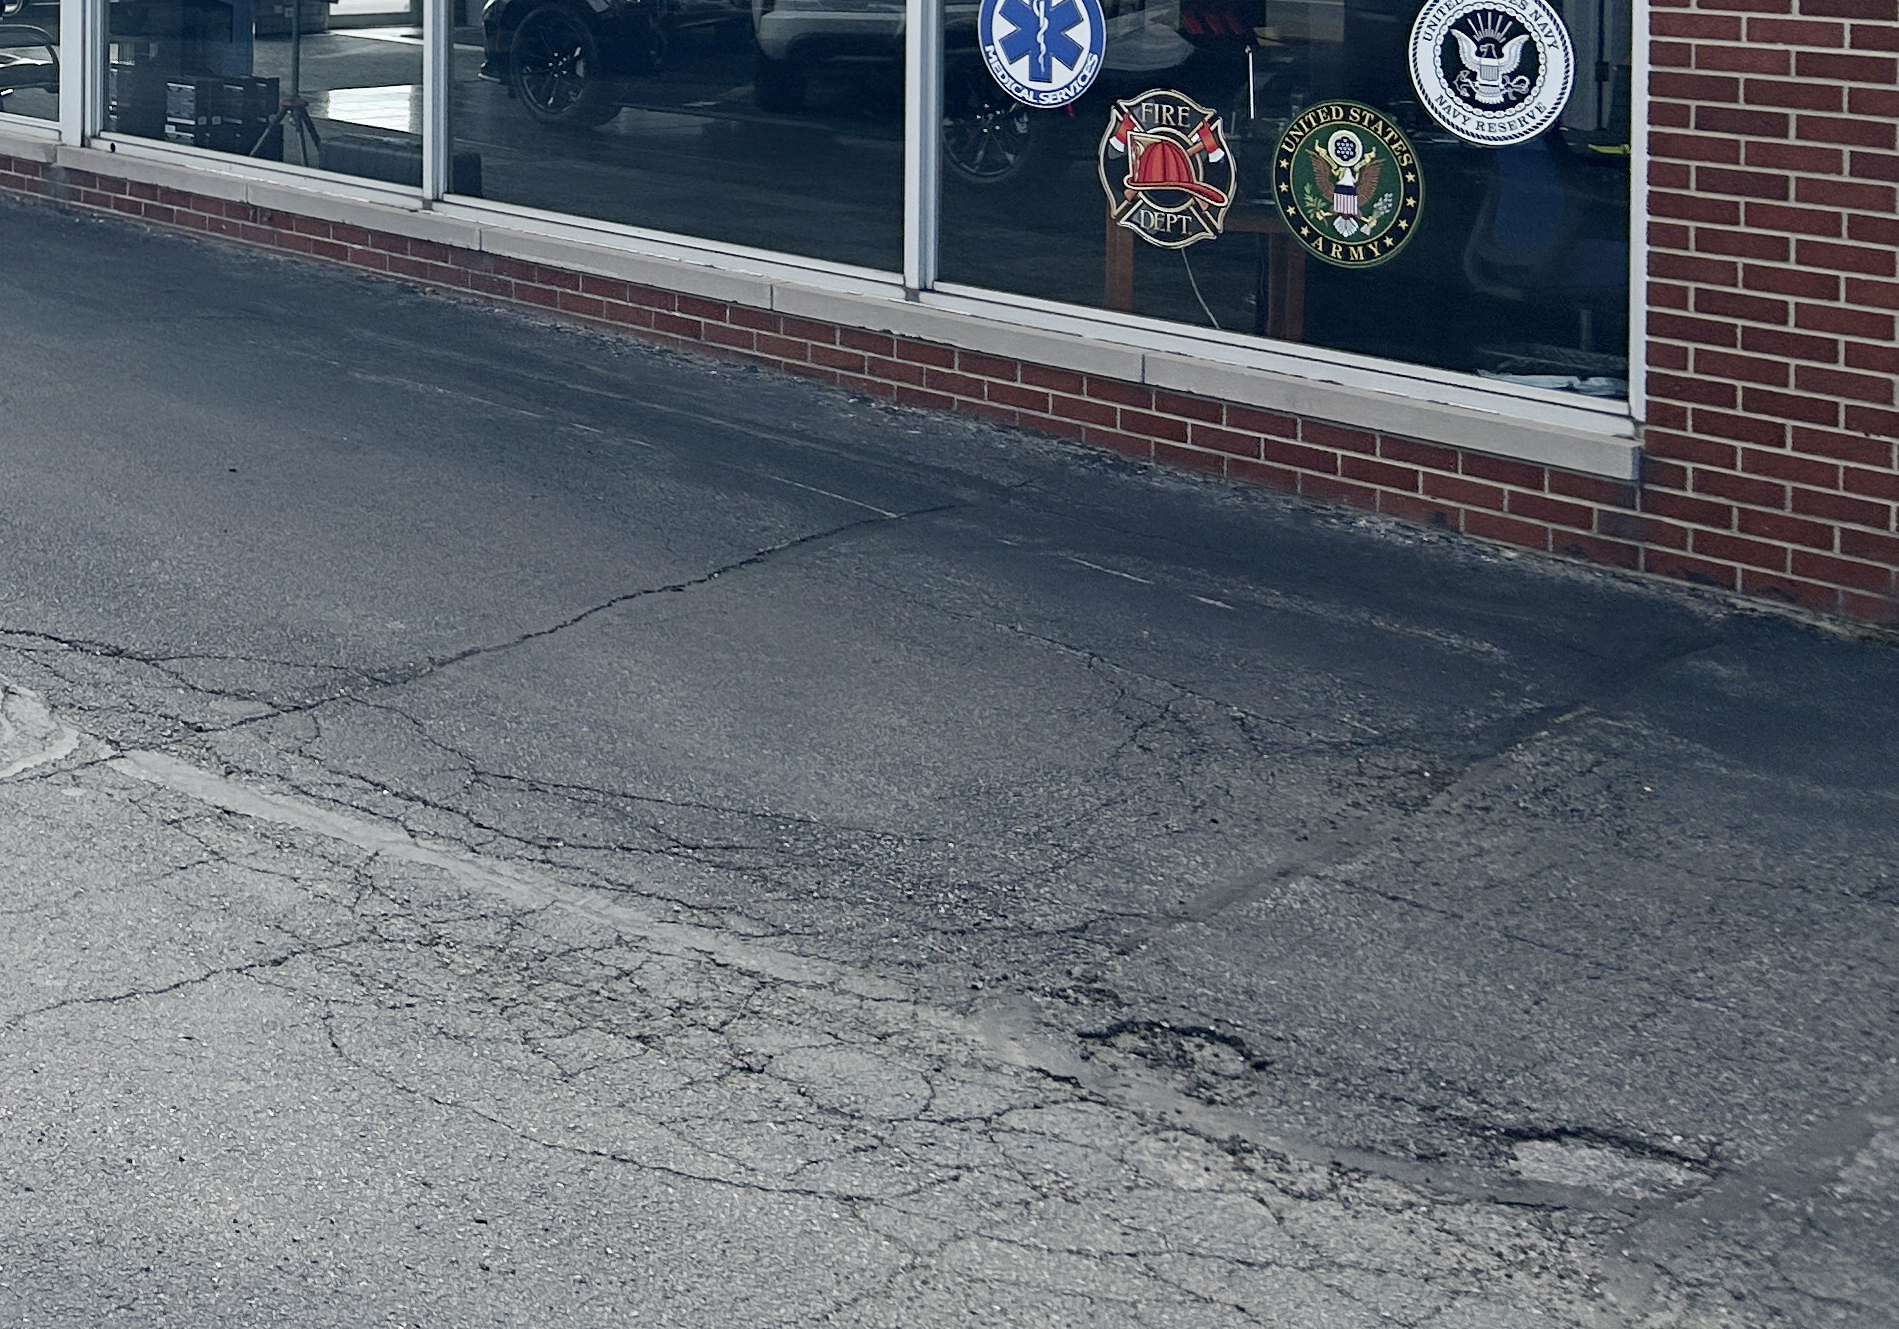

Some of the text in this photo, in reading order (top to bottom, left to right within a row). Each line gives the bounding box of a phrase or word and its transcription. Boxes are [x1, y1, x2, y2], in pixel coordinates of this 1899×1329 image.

[1529, 10, 1560, 51] NAVY
[985, 45, 1099, 104] MEDICAL SERVICES
[1141, 102, 1191, 128] FIRE
[1435, 94, 1547, 133] NAVY RESERVE
[1281, 105, 1413, 167] UNITED STATES
[1311, 236, 1381, 261] ARMY
